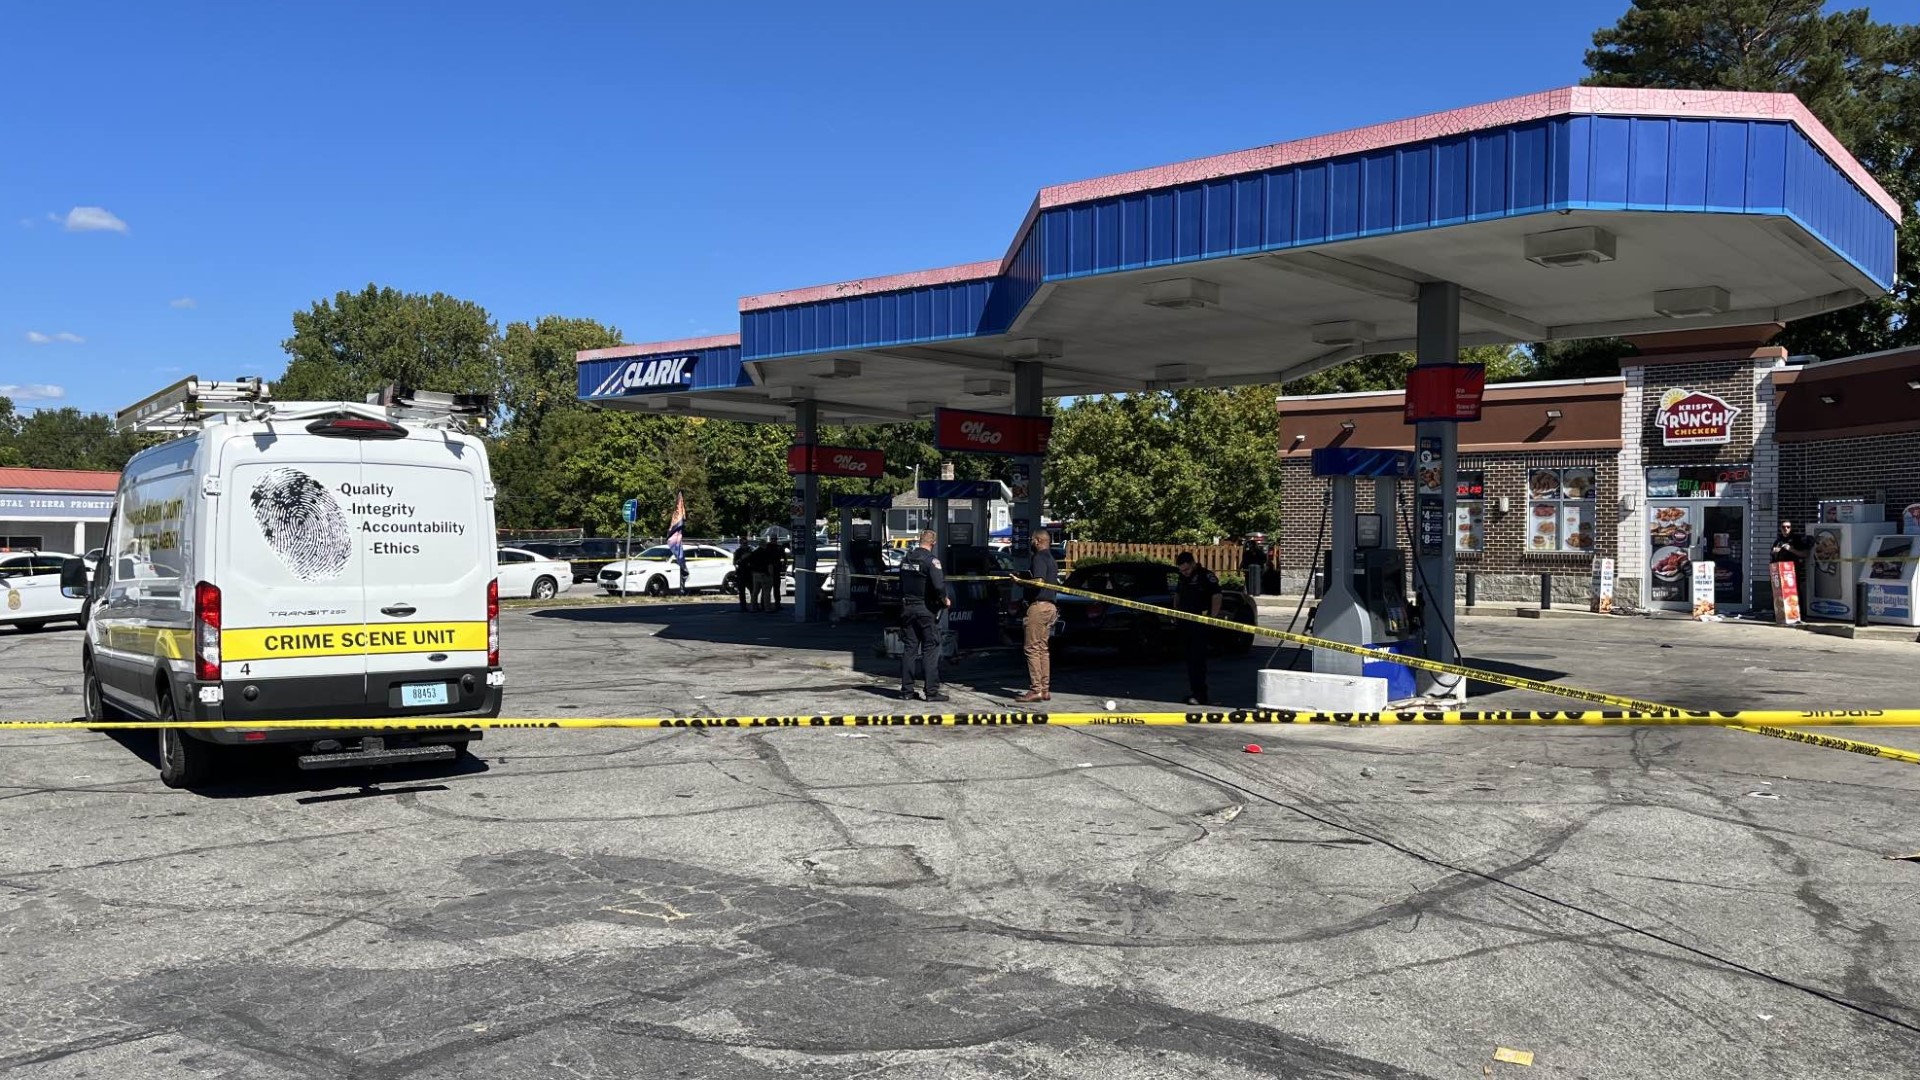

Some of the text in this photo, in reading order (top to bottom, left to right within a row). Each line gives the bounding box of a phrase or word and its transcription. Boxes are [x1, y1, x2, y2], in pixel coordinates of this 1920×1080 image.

[622, 357, 688, 389] CLARK
[1678, 403, 1713, 411] KRISPY
[1658, 409, 1735, 428] KRUNCHY
[960, 421, 985, 434] ON
[1674, 427, 1718, 436] CHICKEN
[979, 430, 1002, 444] GO
[833, 454, 852, 463] ON
[848, 461, 867, 471] GO
[336, 482, 394, 498] -Quality
[1678, 480, 1692, 490] EBT
[29, 500, 65, 508] TIERRA
[347, 502, 415, 518] -Integrity
[357, 521, 465, 536] -Accountability
[369, 542, 420, 554] -Ethics
[268, 609, 329, 617] TRANSIT
[949, 610, 973, 621] CLARK
[265, 630, 456, 651] CRIME SCENE UNIT
[240, 663, 251, 675] 4
[413, 688, 437, 699] 88453
[1758, 726, 1881, 756] CRIME SCENE DO NOT CROSS
